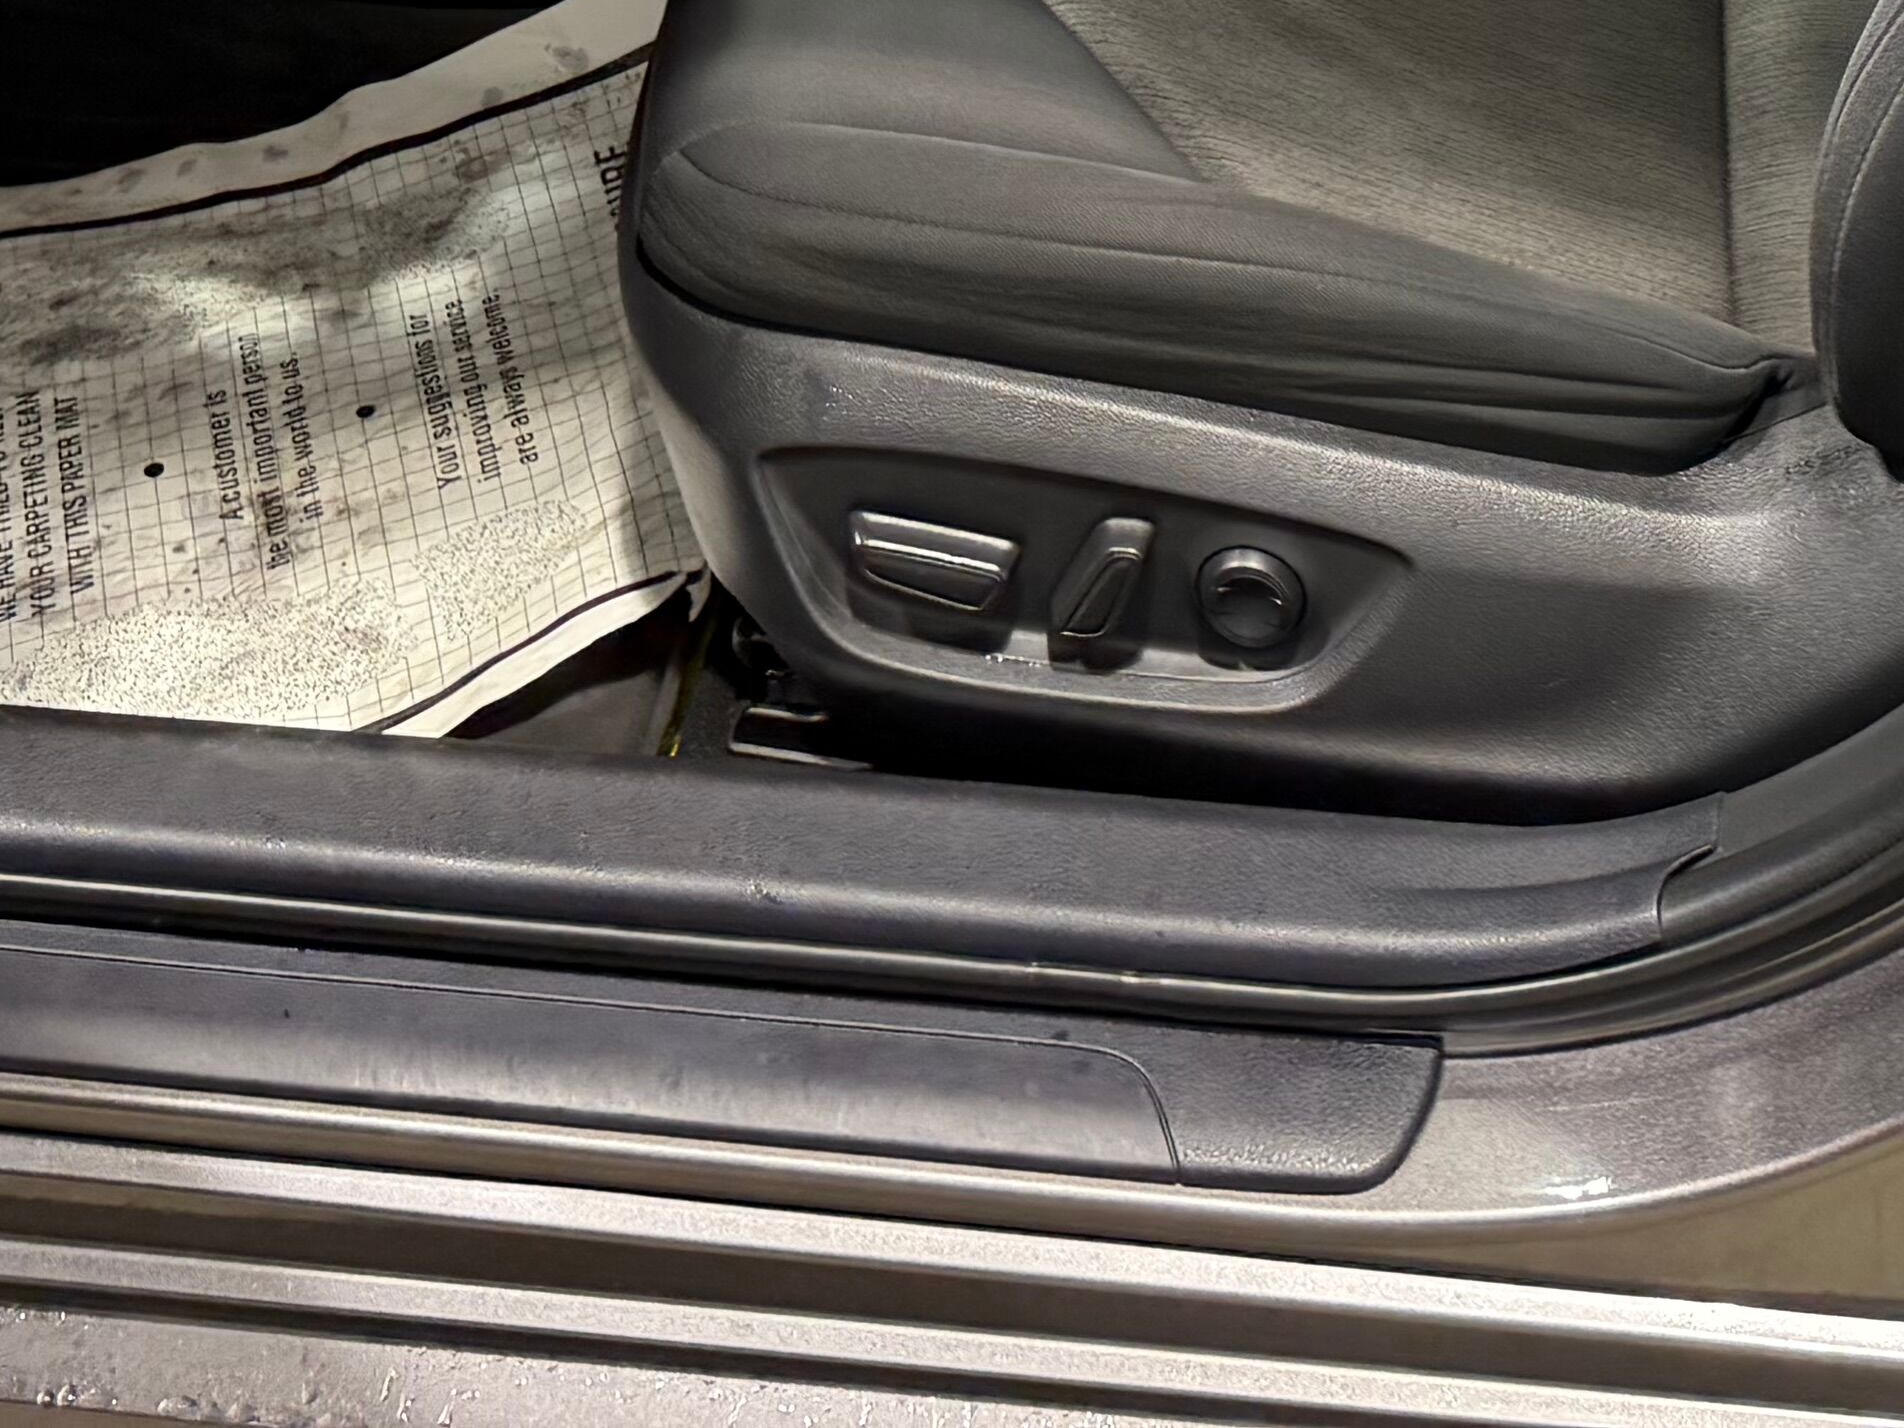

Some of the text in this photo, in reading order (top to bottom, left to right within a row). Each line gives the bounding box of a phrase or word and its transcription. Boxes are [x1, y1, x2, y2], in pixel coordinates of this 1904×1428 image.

[205, 389, 244, 520] A customer is
[238, 333, 291, 570] the most important person
[280, 352, 323, 523] in the world to us.
[407, 314, 462, 490] Your suggestions for
[444, 300, 503, 484] improving our service
[482, 288, 537, 465] are always welcome.
[16, 391, 56, 617] YOUR CARPETING CLEAN
[54, 397, 95, 595] WITH THIS PAPER MAT
